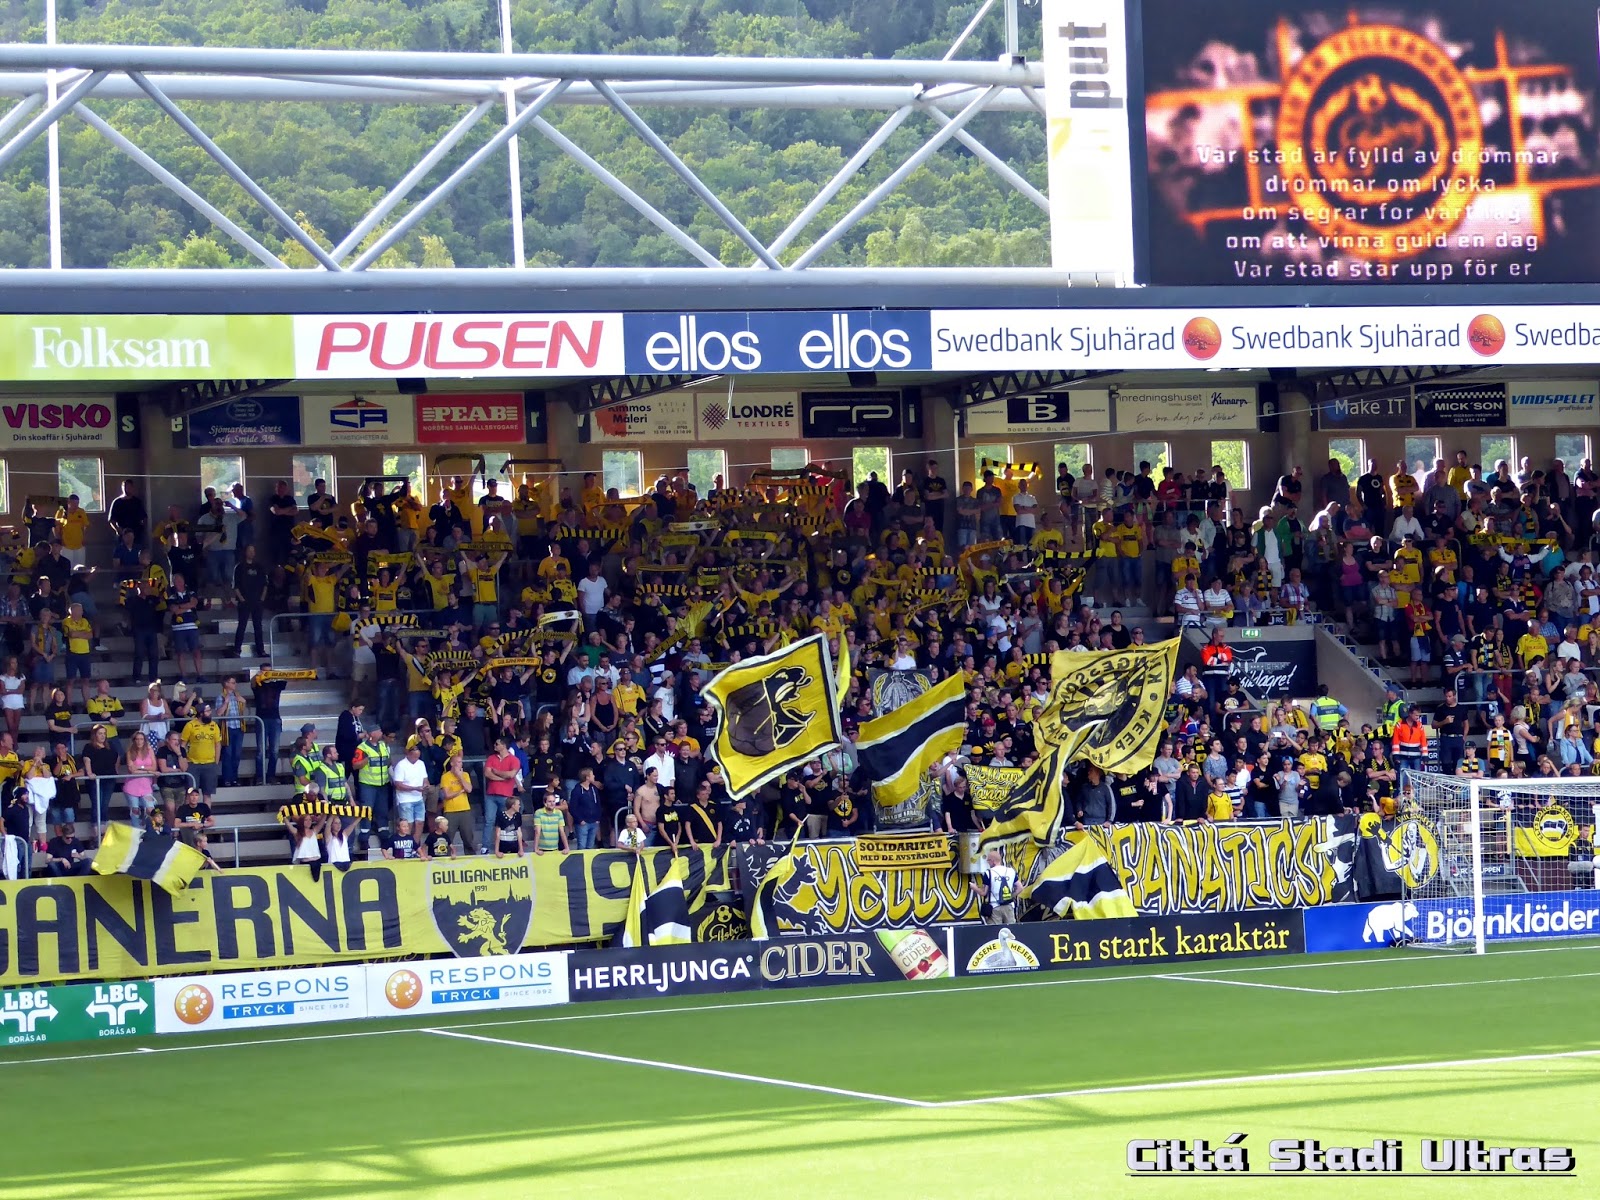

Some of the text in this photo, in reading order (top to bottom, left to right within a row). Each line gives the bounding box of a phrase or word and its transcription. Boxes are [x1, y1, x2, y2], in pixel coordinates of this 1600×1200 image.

[1248, 147, 1303, 163] stad
[1348, 147, 1404, 168] fylld
[1414, 150, 1441, 163] av
[1387, 178, 1421, 193] om
[1432, 175, 1496, 196] lycka
[1242, 206, 1277, 220] om
[1288, 206, 1367, 224] segrar
[1226, 232, 1538, 252] om att vinna guld en dag
[1284, 261, 1339, 277] stad
[1410, 263, 1453, 280] upp
[1464, 259, 1498, 276] för
[1509, 262, 1532, 276] er
[32, 327, 211, 369] Folksam
[316, 320, 604, 371] PULSEN
[645, 315, 762, 372] ellos
[798, 313, 912, 369] ellos
[936, 326, 1175, 357] Swedbank Sjuhärad
[1232, 323, 1460, 354] Swedbank Sjuhärad
[1118, 392, 1202, 404] inredningshuset
[1335, 398, 1406, 415] Make IT
[1511, 393, 1596, 405] VINDSPELET
[2, 403, 111, 429] VISKO
[433, 406, 508, 422] PEAB
[731, 402, 794, 419] LONDRÉ
[13, 434, 27, 442] Din
[29, 433, 60, 442] skoaffär
[66, 433, 103, 443] Sjuhärad!
[208, 423, 257, 436] Sjömarkens
[215, 434, 231, 443] och
[232, 434, 259, 443] Smide
[859, 839, 943, 852] SOLIDARITET
[895, 851, 948, 861] AVSTÄNGDA
[432, 865, 529, 885] GULIGANERNA
[0, 867, 402, 977] ANERNA
[1426, 900, 1600, 946] Bjönkläder
[1050, 921, 1290, 964] En stark karaktär
[760, 941, 876, 982] CIDER
[901, 942, 929, 968] CIDER
[1010, 943, 1036, 965] MEJERI
[430, 962, 552, 985] RESPONS
[574, 957, 750, 992] HERRLJUNGA
[95, 983, 139, 1004] LBC
[221, 976, 349, 1000] RESPONS
[439, 988, 493, 1002] TRYCK
[504, 989, 530, 997] SINCE
[4, 989, 48, 1010] LBC
[231, 1002, 350, 1016] TRYCK SINCE 1992
[8, 1034, 33, 1044] BORÅS
[99, 1026, 137, 1037] BORÅS AB
